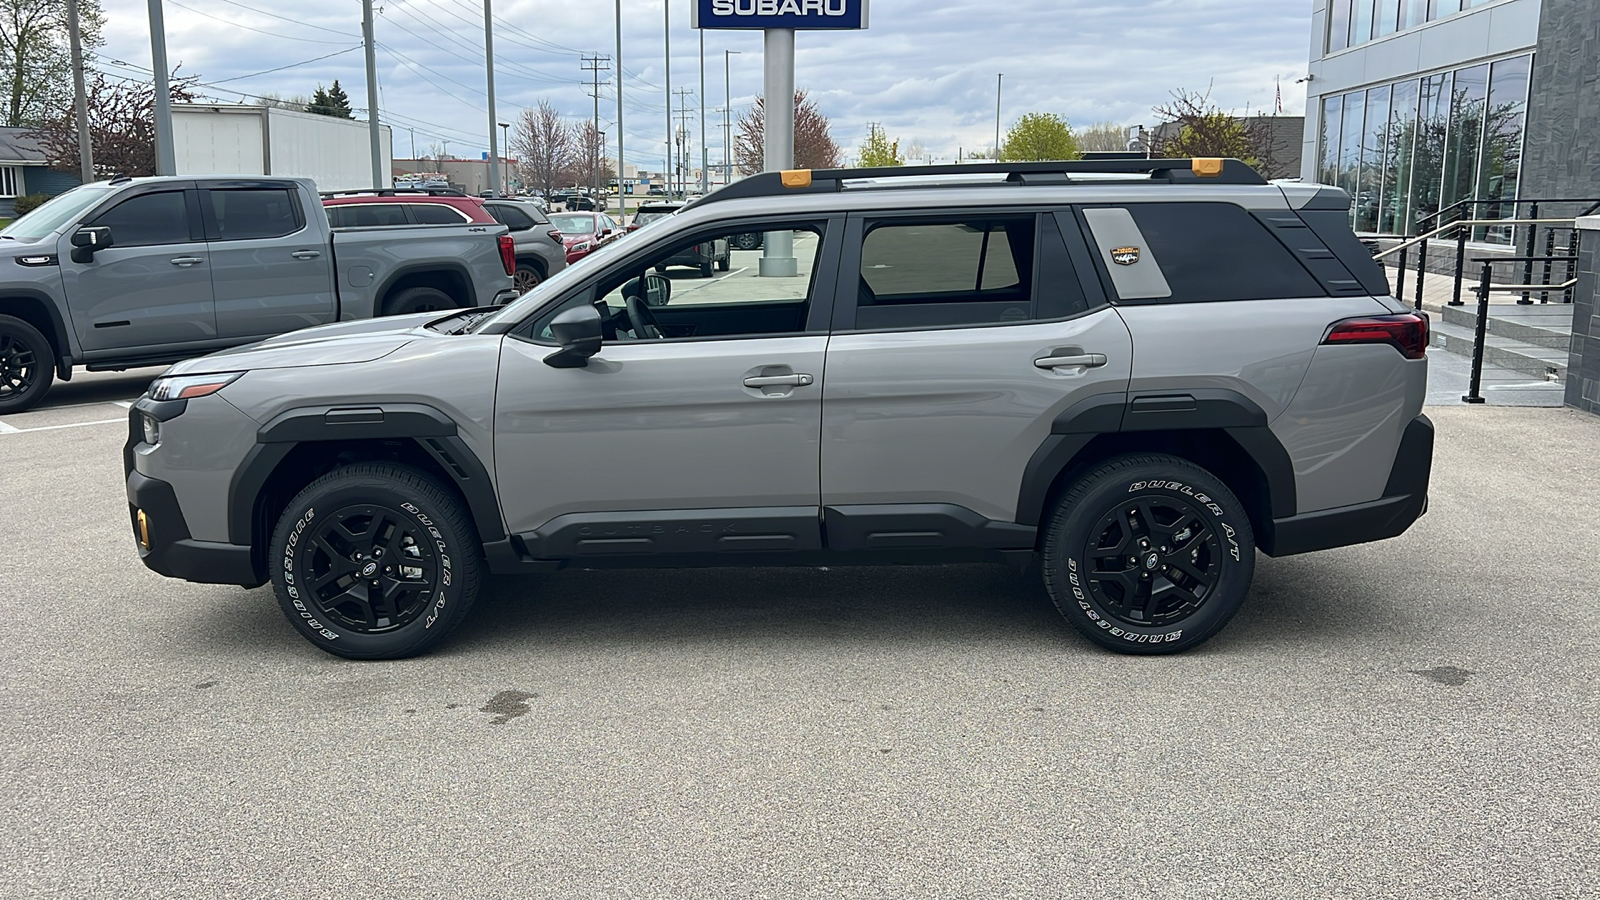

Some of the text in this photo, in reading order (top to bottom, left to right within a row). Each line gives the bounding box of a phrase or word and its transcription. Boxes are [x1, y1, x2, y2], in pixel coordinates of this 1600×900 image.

[712, 0, 847, 16] SUBARU
[578, 522, 737, 536] OUTBACK
[1128, 480, 1241, 562] DUELER A/T
[283, 507, 340, 641] BRIDGESTONE
[401, 502, 452, 629] DUELER A/T
[1066, 557, 1183, 644] BRIDGESTONE
